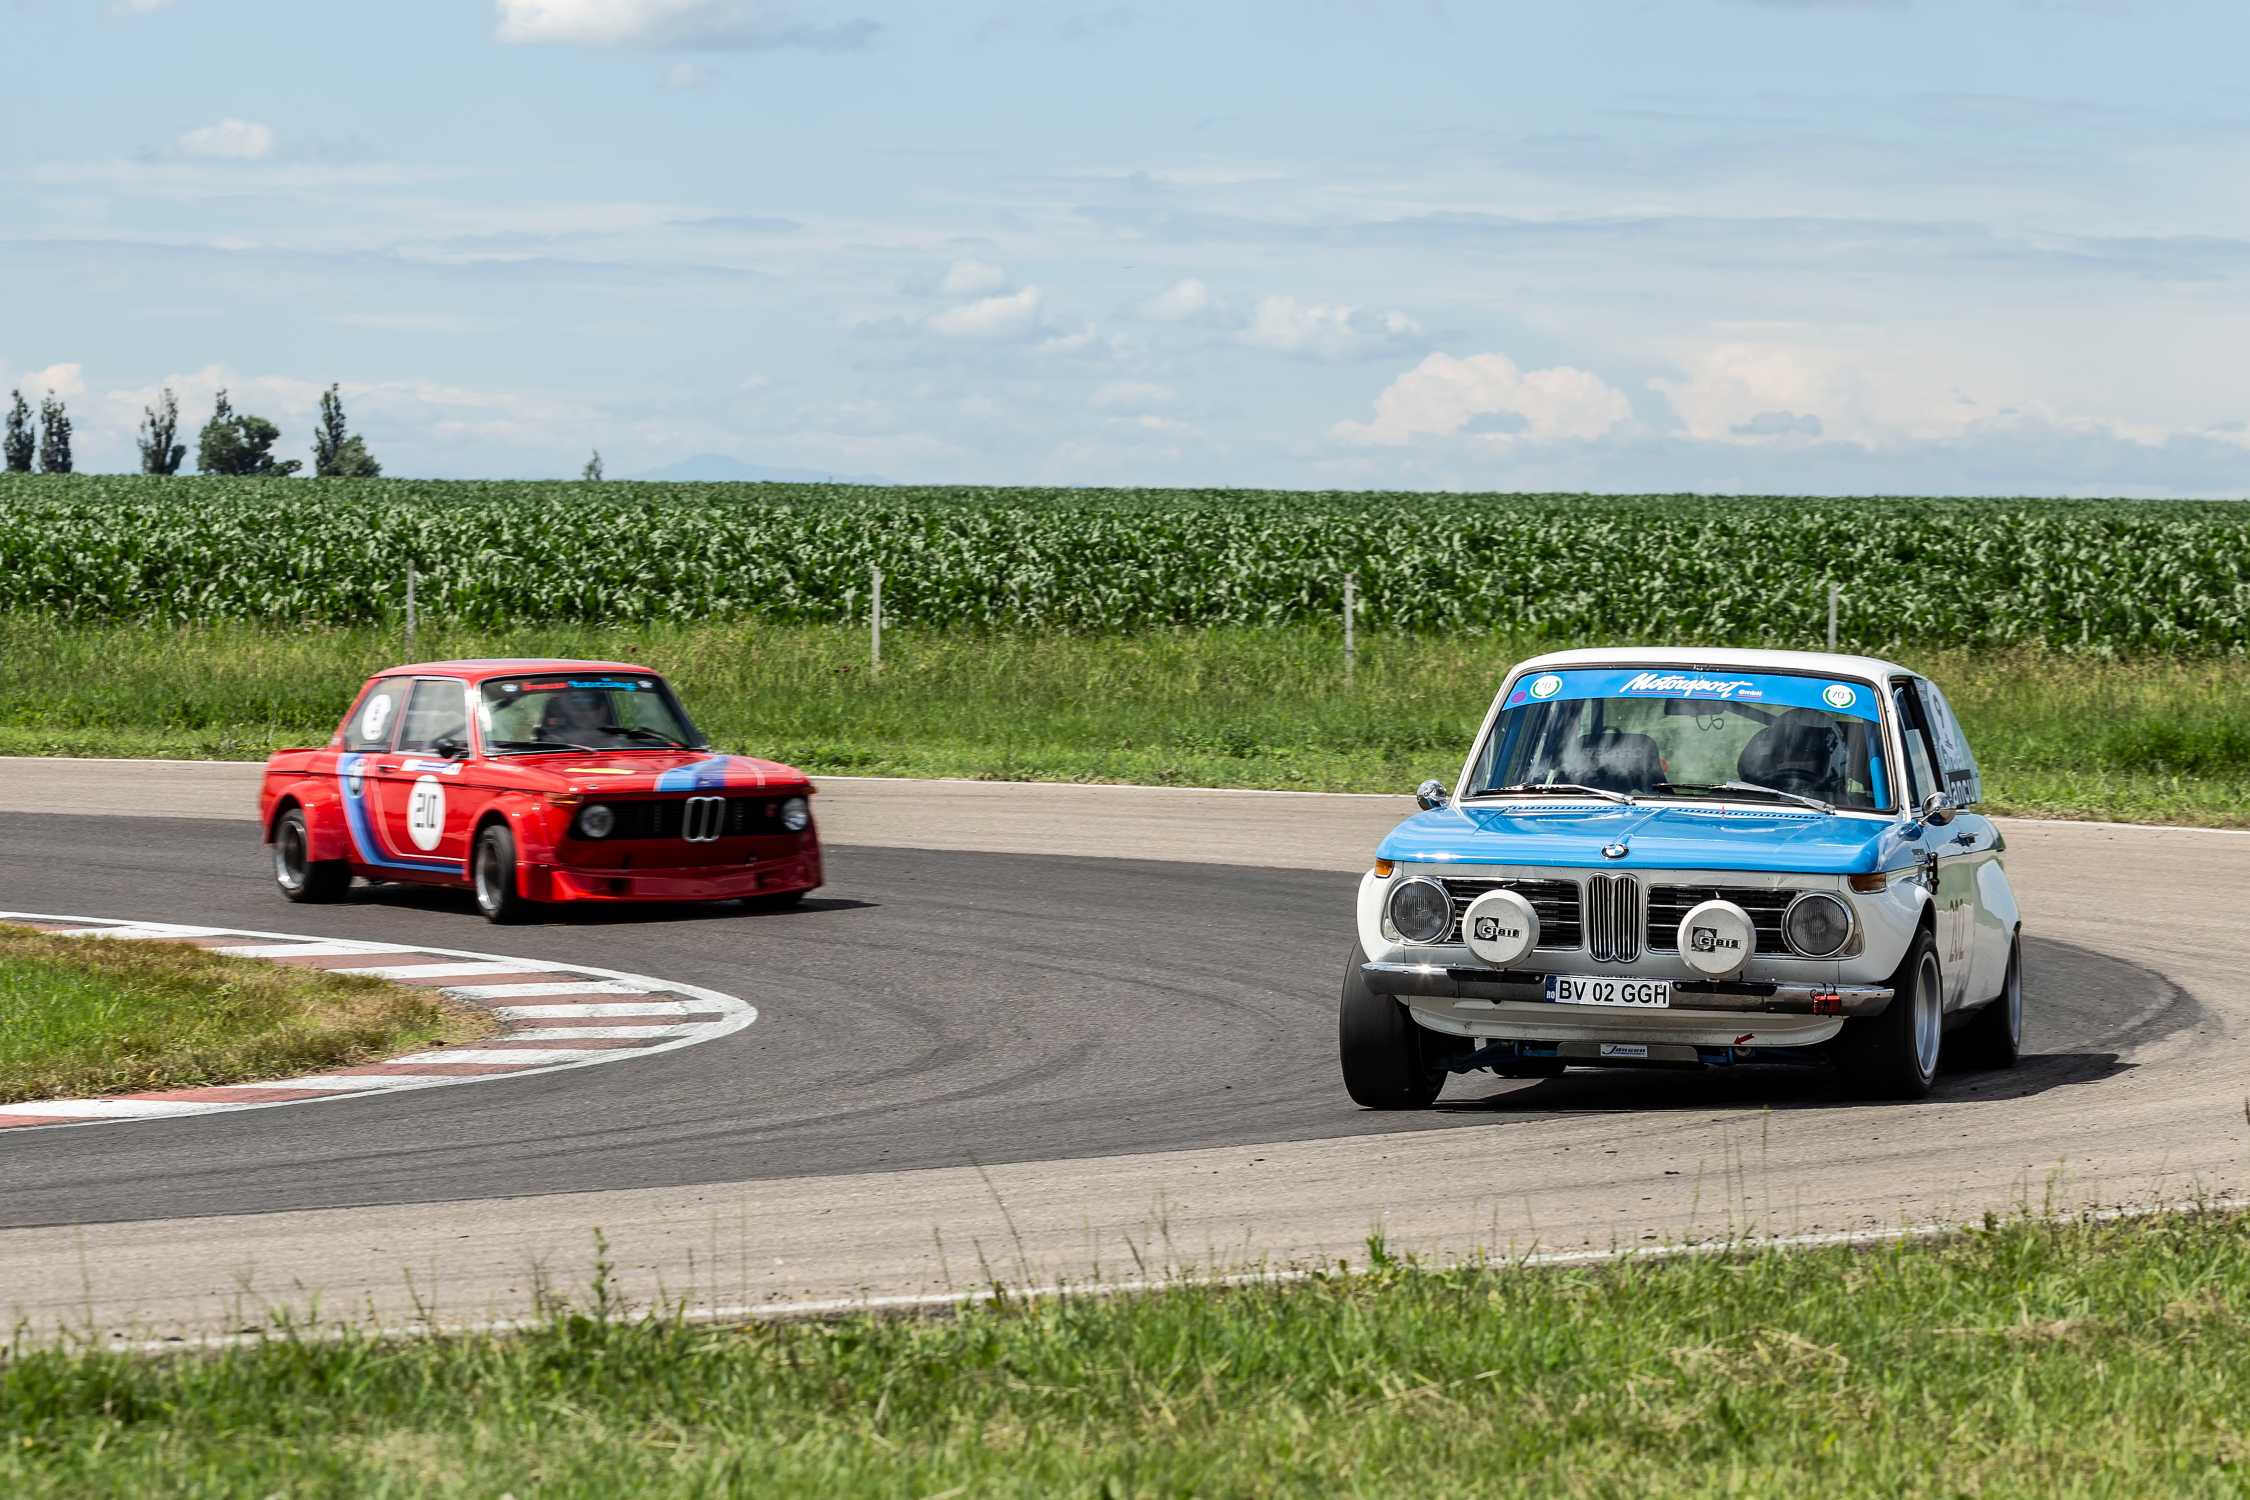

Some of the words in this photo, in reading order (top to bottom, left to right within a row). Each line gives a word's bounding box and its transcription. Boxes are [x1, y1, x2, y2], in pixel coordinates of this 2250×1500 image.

[1619, 672, 1753, 699] Motorsport
[1559, 980, 1587, 1000] BV
[1592, 982, 1614, 1002] 02
[1621, 984, 1667, 1004] GGH
